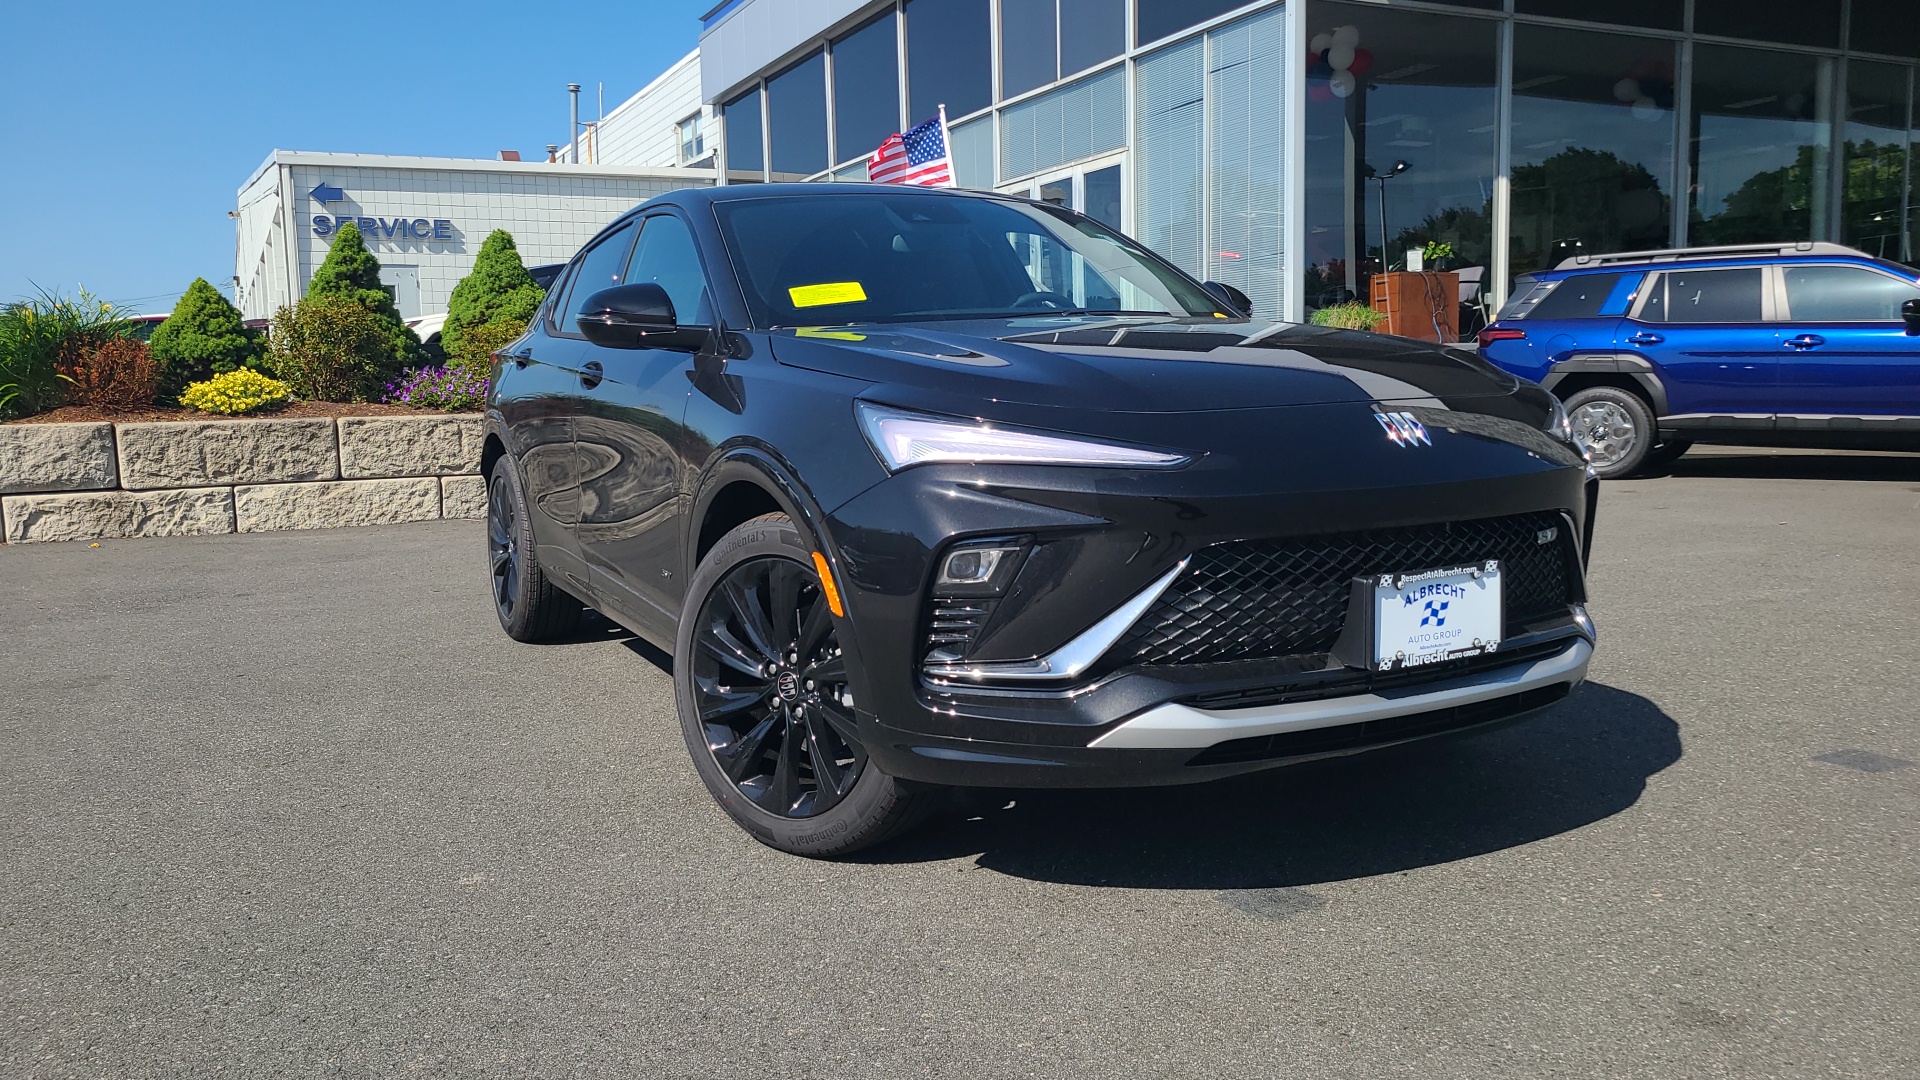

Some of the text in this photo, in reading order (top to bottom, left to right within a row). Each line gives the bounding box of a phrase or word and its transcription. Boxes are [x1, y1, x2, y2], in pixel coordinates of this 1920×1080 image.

[312, 215, 452, 239] SERVICE
[713, 531, 759, 566] Continental
[1404, 583, 1466, 608] ALBRECHT
[1408, 628, 1462, 645] AUTO GROUP
[1401, 648, 1480, 668] Albrecht AUTO GROUP
